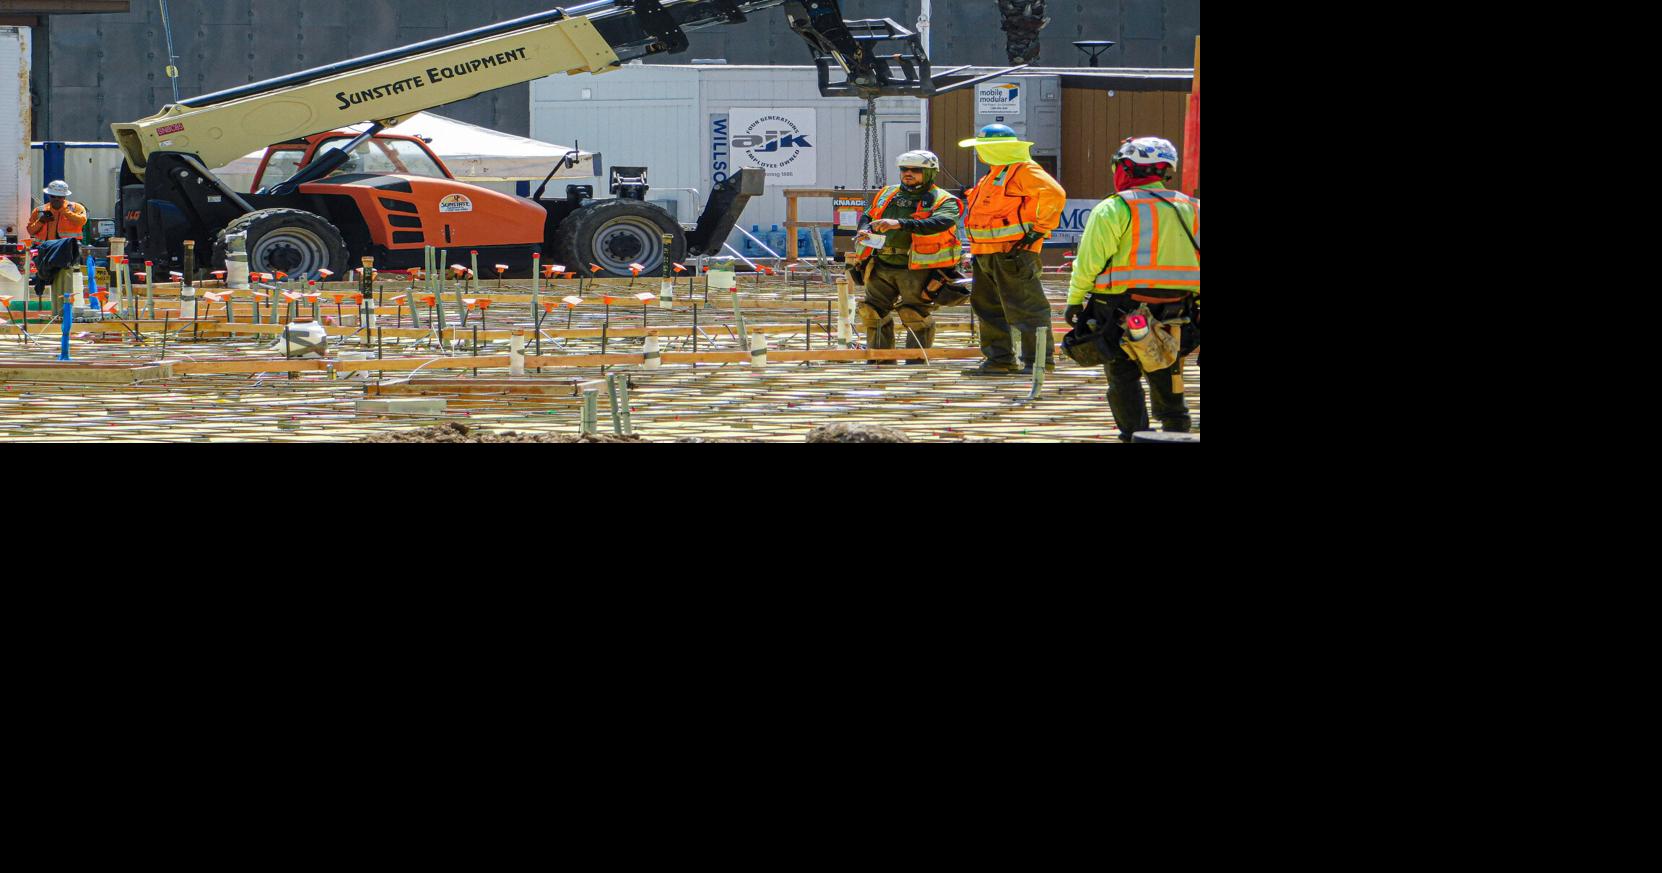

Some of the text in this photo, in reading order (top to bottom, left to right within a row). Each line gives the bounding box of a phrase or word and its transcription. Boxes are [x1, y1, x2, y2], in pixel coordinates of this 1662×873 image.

[335, 47, 526, 110] SUNSTATE EQUIPMENT
[746, 115, 799, 134] FOUR GENERATIONS
[731, 130, 813, 152] ajk
[746, 149, 800, 168] EMPLOYEE OWNED
[125, 211, 141, 221] JLG
